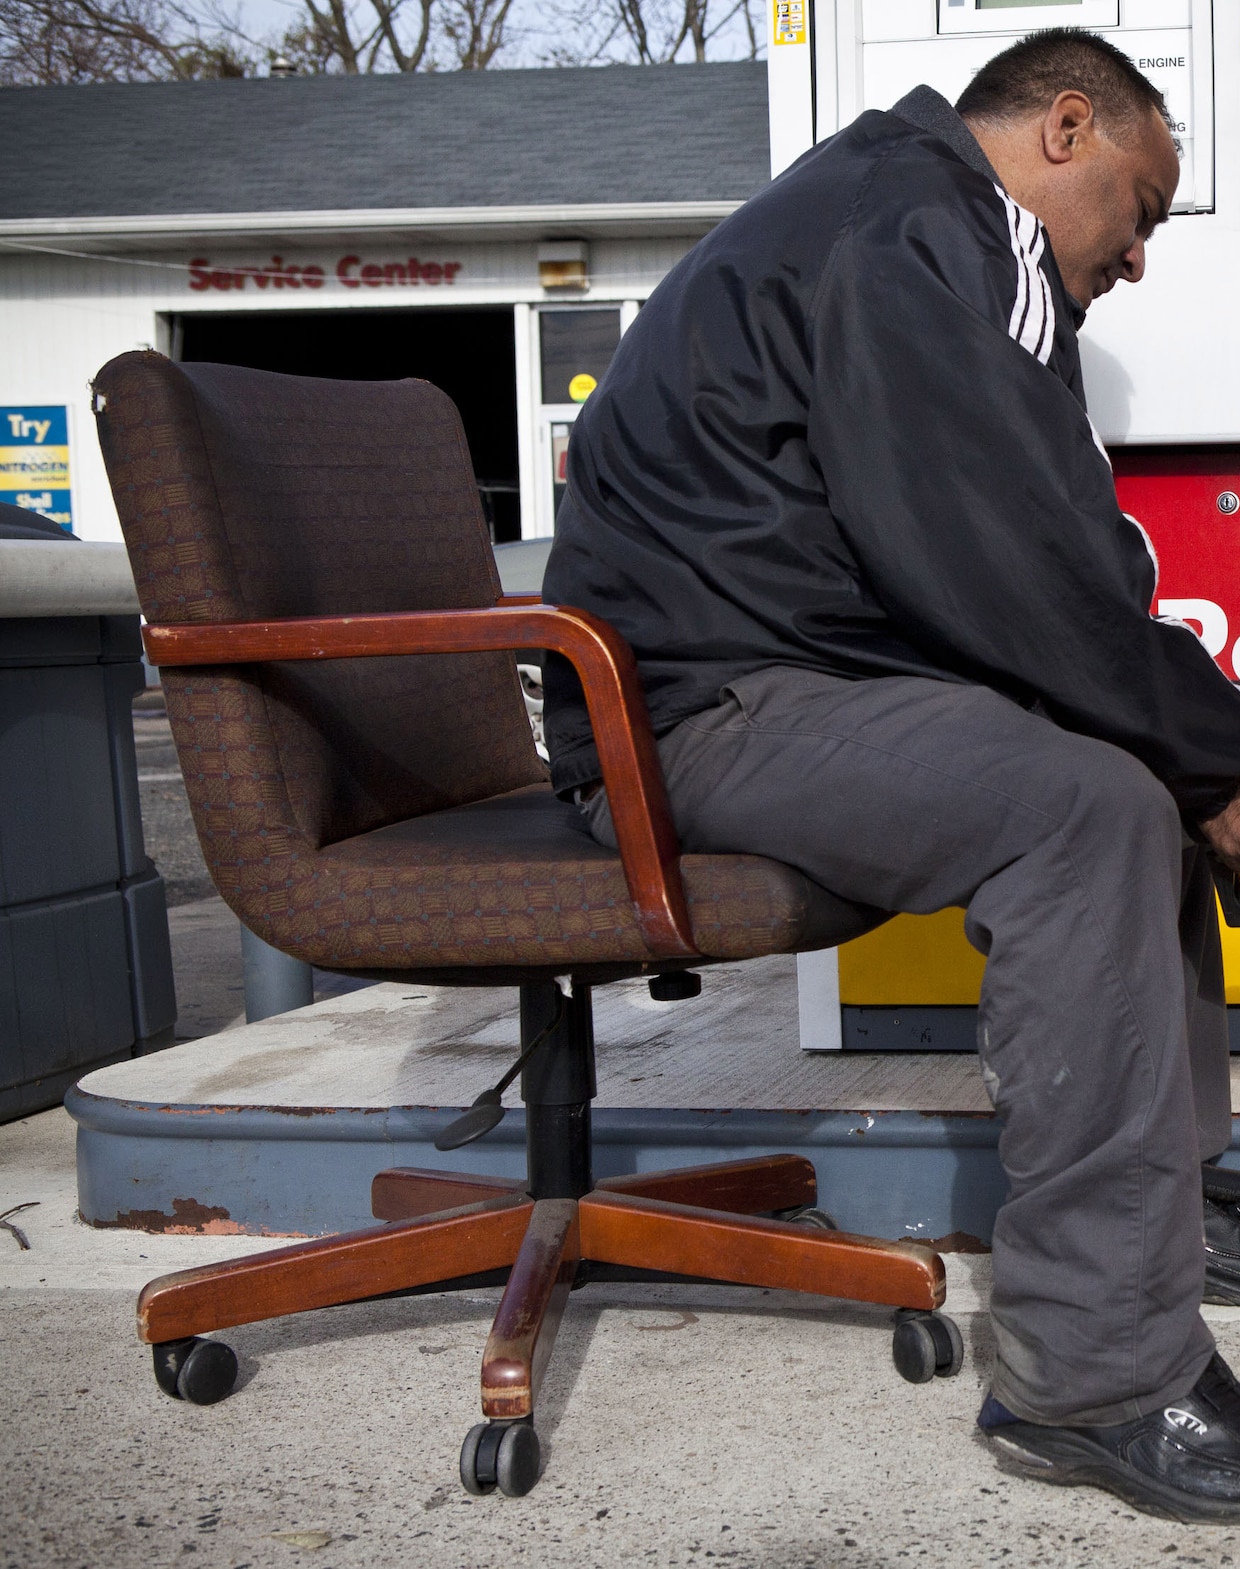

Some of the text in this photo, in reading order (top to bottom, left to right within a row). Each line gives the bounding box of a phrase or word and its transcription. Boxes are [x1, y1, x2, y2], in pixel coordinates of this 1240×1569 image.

[1139, 57, 1185, 68] ENGINE
[189, 255, 462, 291] Service Center
[8, 414, 51, 443] Try
[1174, 1416, 1208, 1436] AIR
